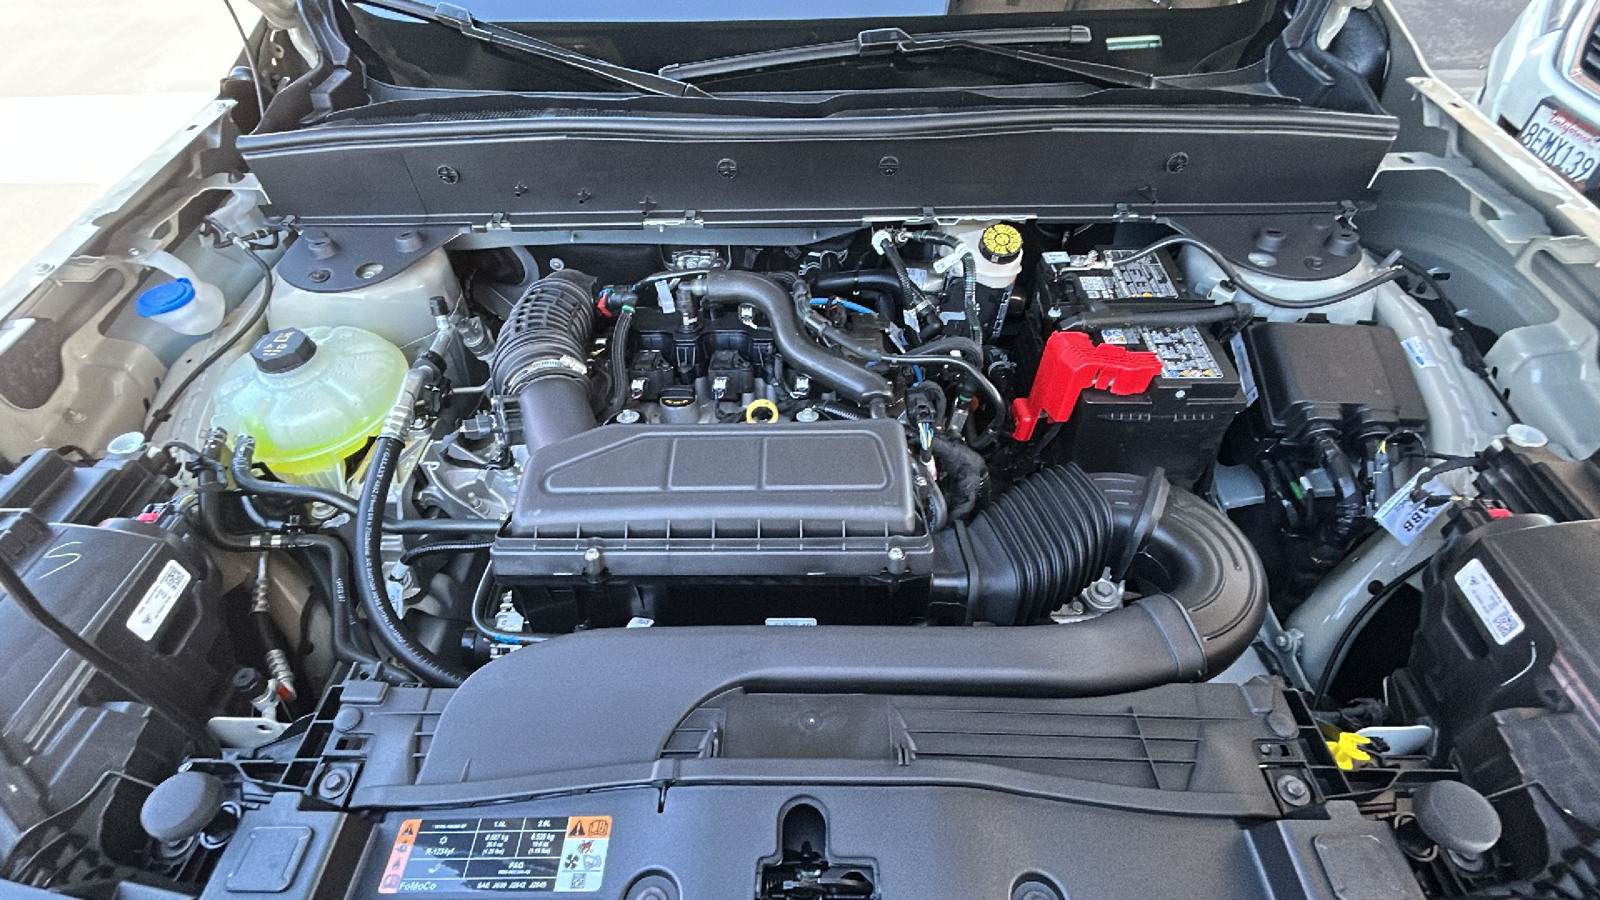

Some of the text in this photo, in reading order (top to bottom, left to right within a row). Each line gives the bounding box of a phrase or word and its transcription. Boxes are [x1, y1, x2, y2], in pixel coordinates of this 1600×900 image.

[1521, 122, 1595, 180] 8EMX139
[425, 847, 455, 857] R-1234yf
[508, 861, 524, 869] PAG
[399, 881, 437, 892] FoMoCo
